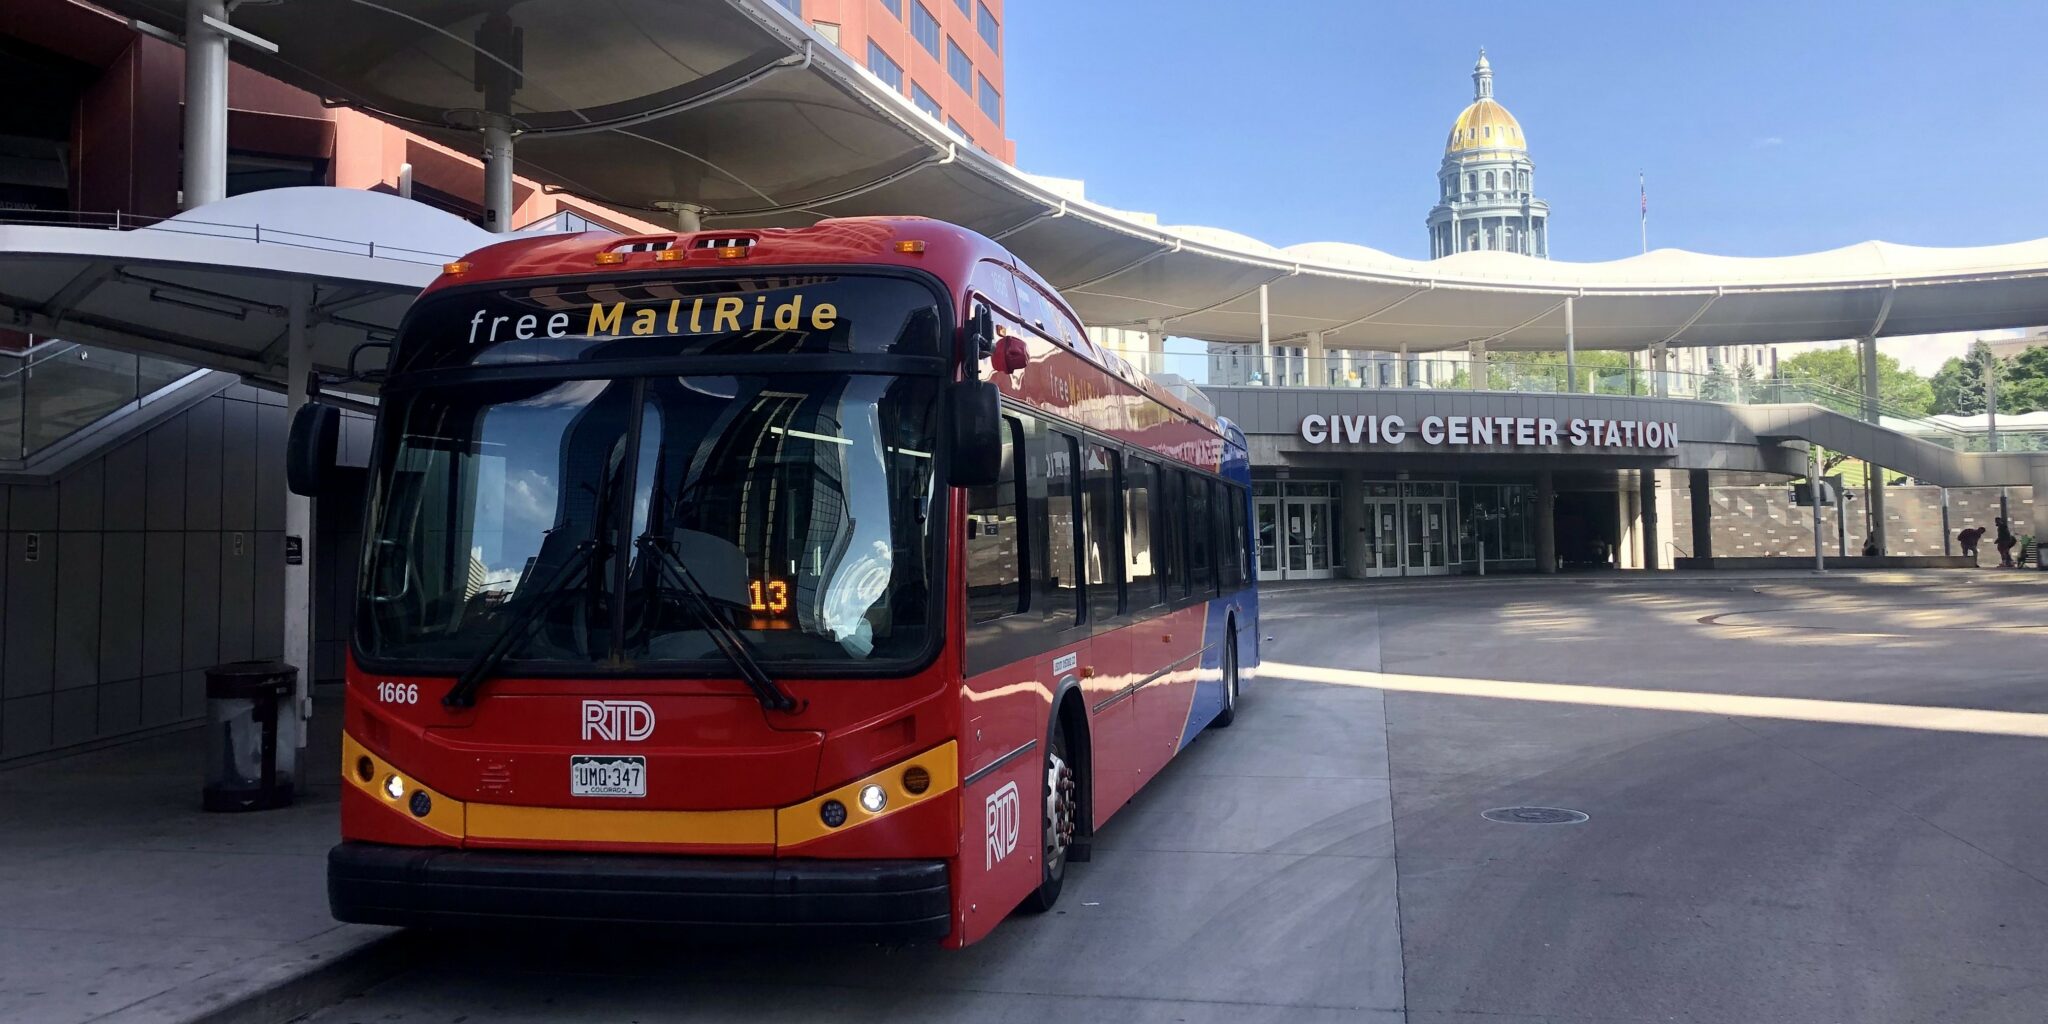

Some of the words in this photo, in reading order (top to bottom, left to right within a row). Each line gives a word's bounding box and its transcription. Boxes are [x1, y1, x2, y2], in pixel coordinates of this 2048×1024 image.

[468, 309, 569, 344] free
[586, 295, 838, 338] MallRide
[1301, 414, 1406, 444] CIVIC
[1420, 416, 1559, 446] CENTER
[1569, 418, 1679, 448] STATION
[750, 580, 787, 610] 13
[377, 682, 418, 705] 1666
[582, 700, 656, 741] RTD
[986, 781, 1020, 872] RTD
